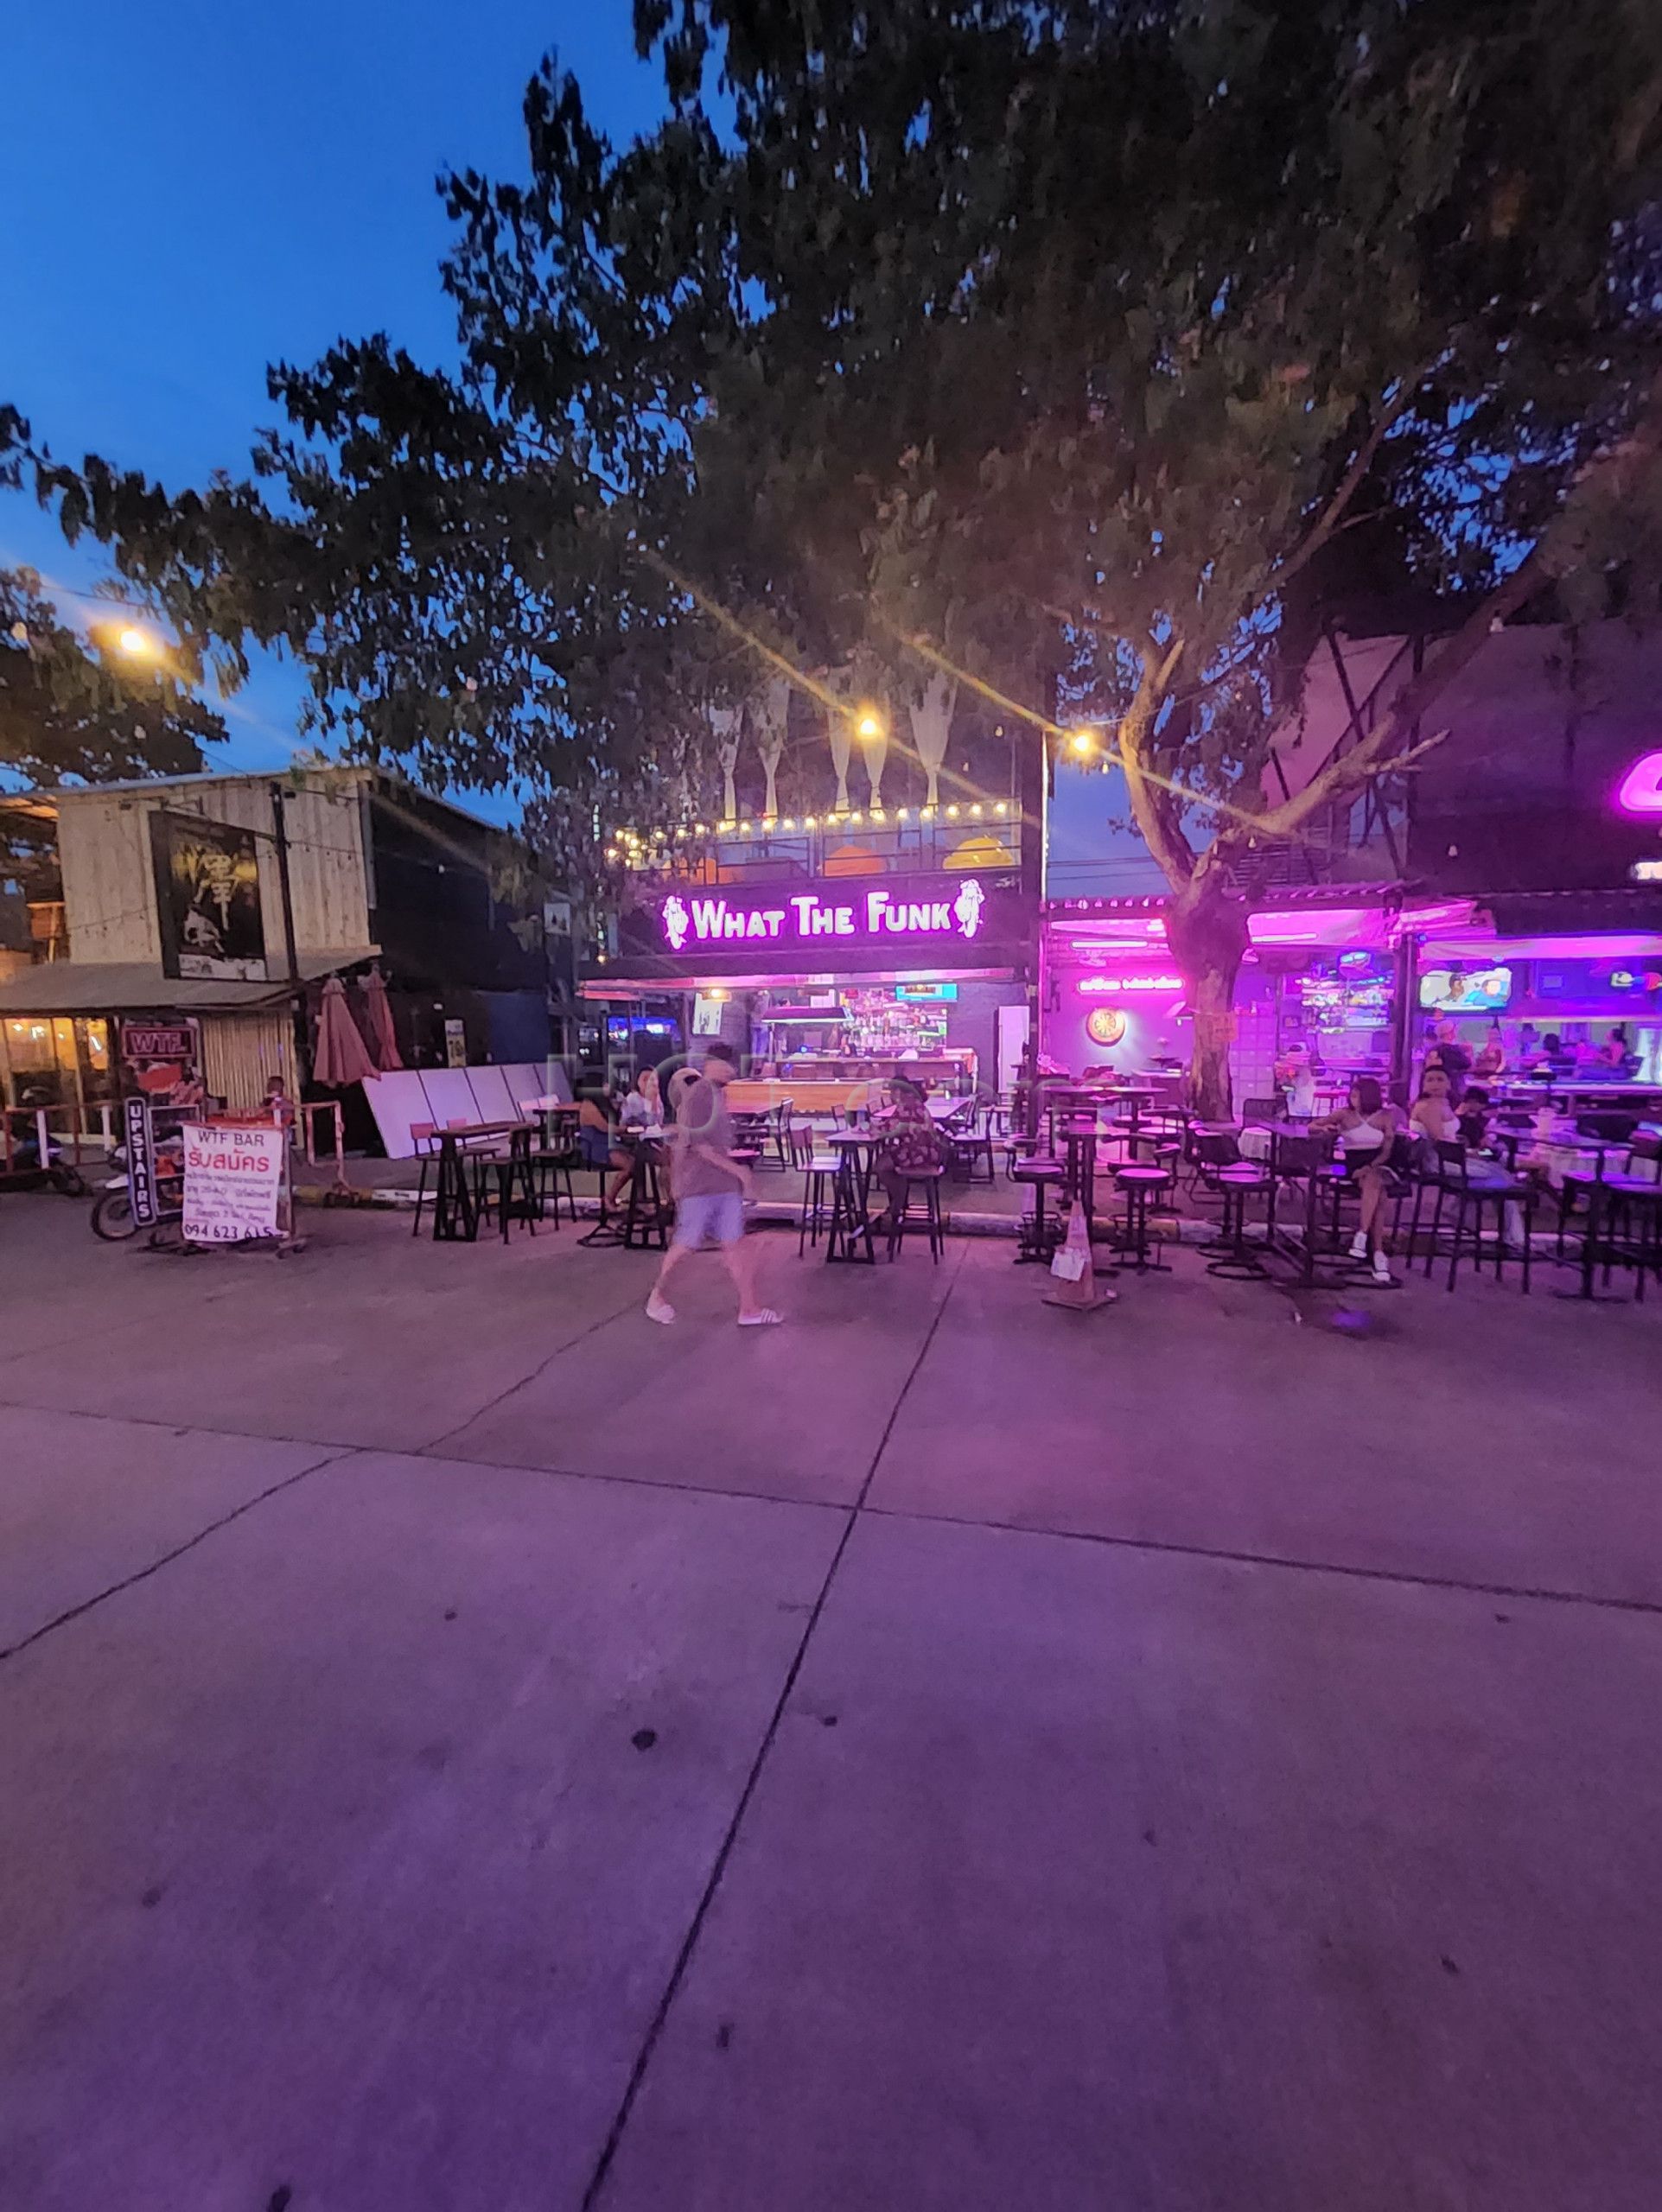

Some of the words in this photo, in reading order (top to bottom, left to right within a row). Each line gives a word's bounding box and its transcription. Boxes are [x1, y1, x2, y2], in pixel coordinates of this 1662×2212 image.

[691, 899, 785, 939] WHAT
[790, 895, 855, 936] THE
[867, 891, 952, 933] FUNK
[198, 1130, 228, 1145] WTF
[233, 1133, 265, 1147] BAR
[129, 1105, 151, 1218] UPSTAIRS
[188, 1147, 270, 1173] รับสมัคร
[184, 1224, 208, 1237] 094
[213, 1224, 238, 1239] 623
